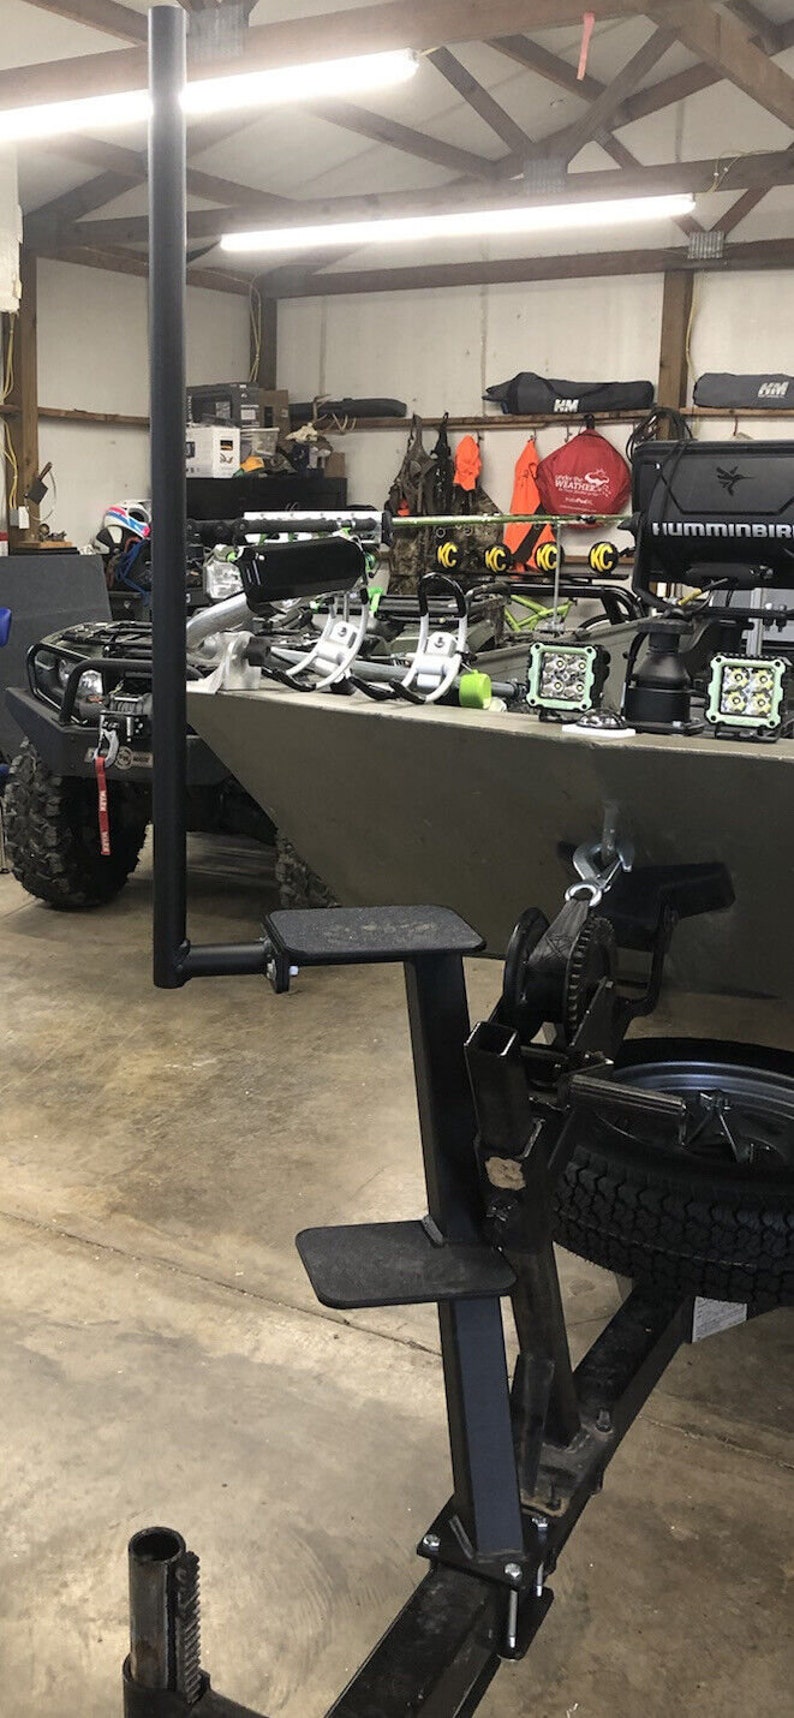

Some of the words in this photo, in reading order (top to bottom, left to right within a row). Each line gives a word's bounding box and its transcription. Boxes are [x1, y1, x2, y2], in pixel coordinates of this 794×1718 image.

[652, 522, 794, 538] HUMMINBIR
[437, 542, 457, 569] KC
[485, 547, 506, 573] KC
[536, 543, 558, 570] KC
[590, 542, 613, 570] KC
